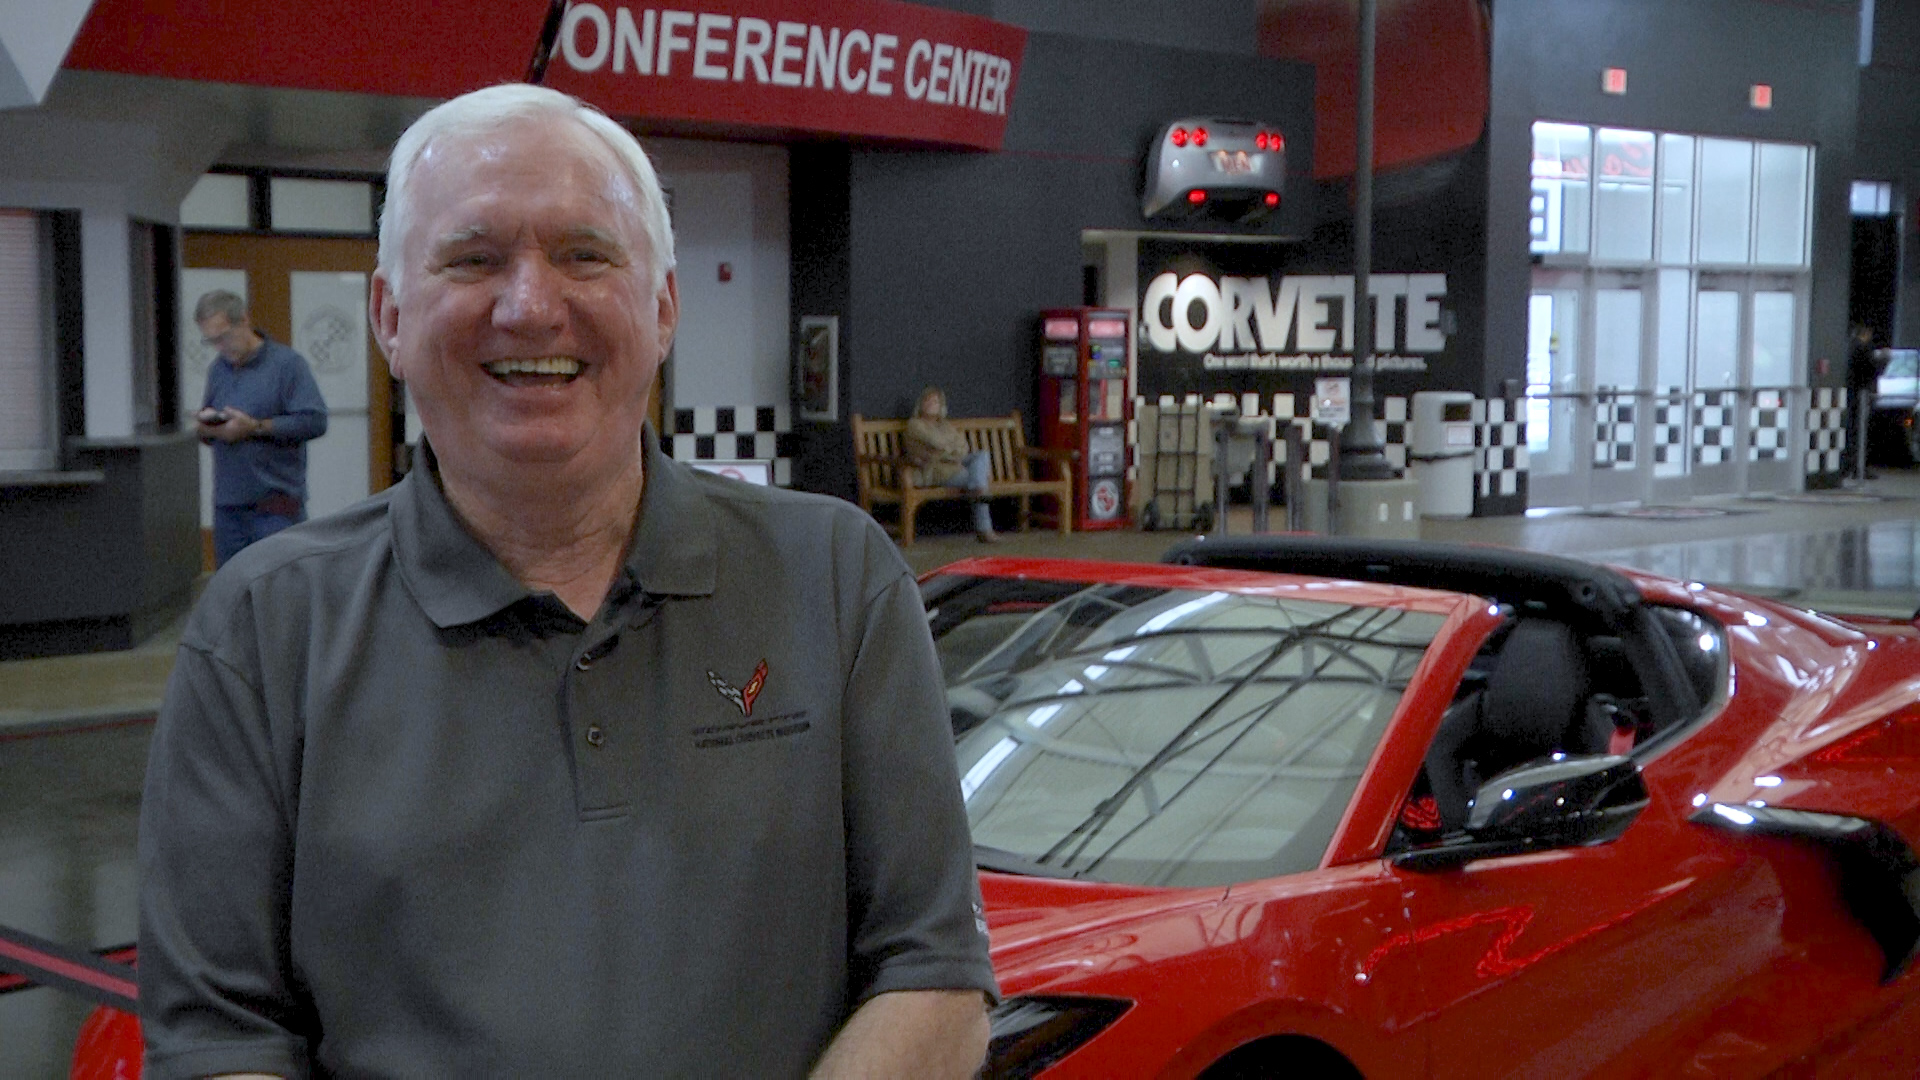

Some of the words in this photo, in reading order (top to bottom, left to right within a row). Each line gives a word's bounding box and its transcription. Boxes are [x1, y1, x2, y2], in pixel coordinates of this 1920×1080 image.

[549, 2, 899, 96] ONFERENCE
[903, 38, 1011, 115] CENTER
[1142, 272, 1447, 353] CORVETTE
